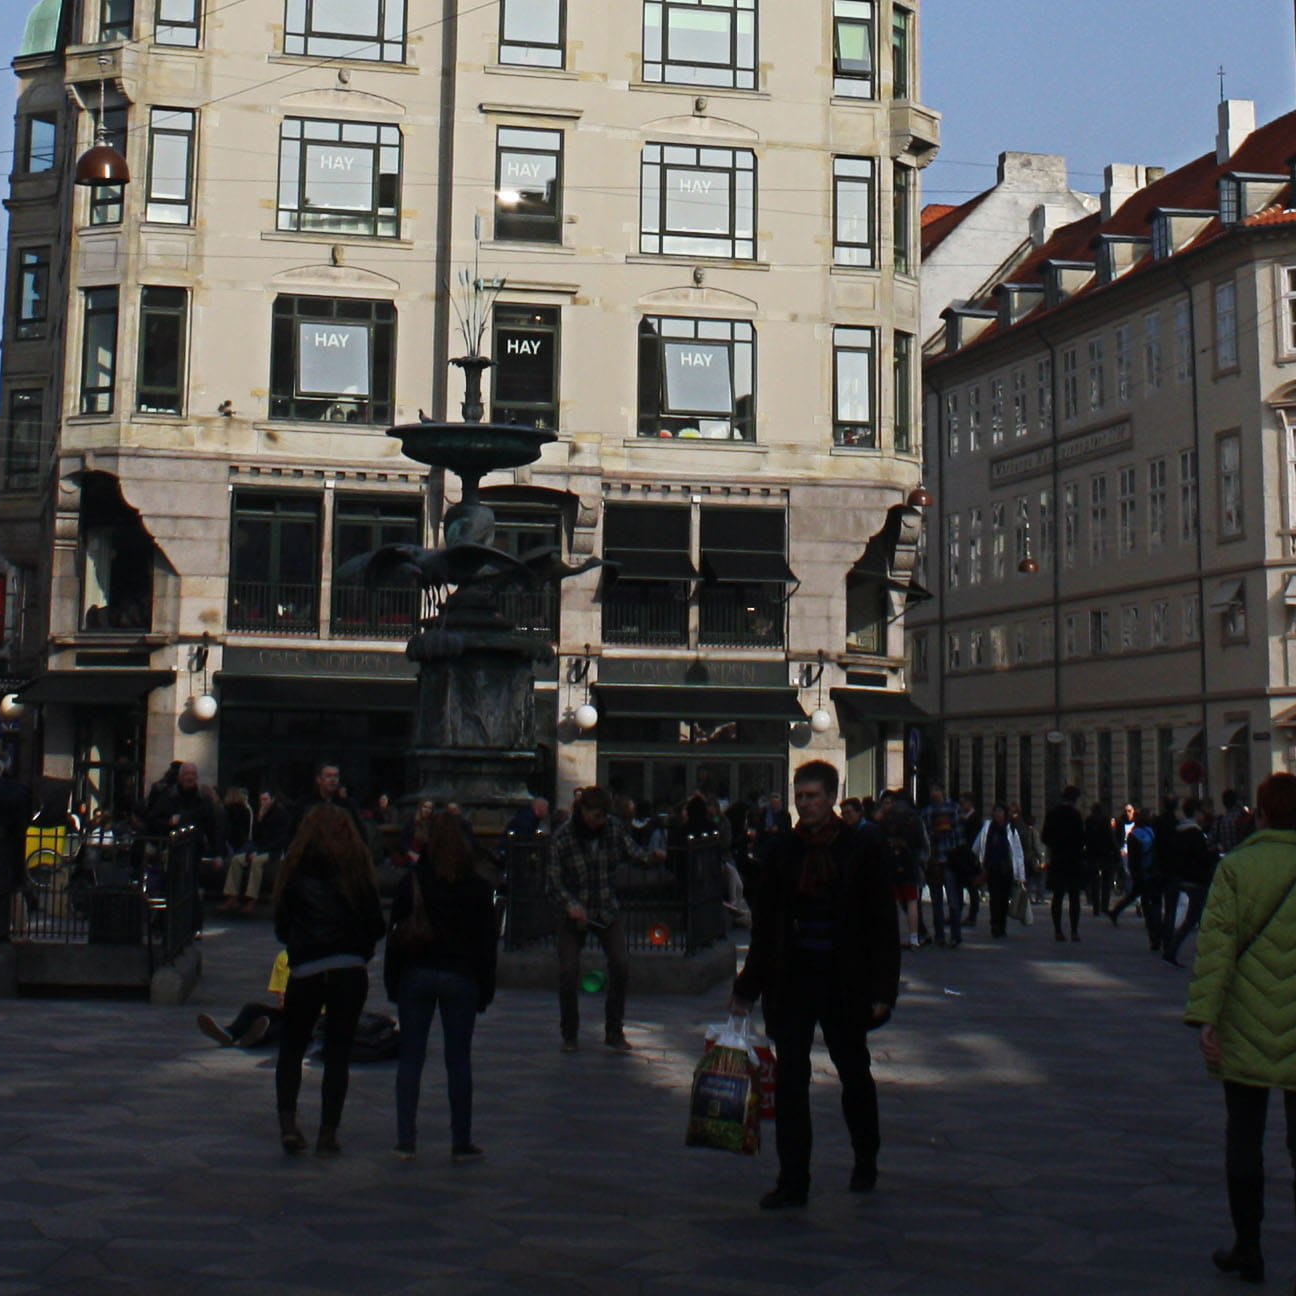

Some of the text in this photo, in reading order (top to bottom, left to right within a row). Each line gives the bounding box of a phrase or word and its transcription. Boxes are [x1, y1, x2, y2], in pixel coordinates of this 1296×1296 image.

[321, 155, 354, 171] HAY
[507, 161, 541, 179] HAY
[680, 178, 712, 195] HAY
[315, 333, 350, 349] HAY
[507, 339, 542, 356] HAY
[680, 352, 714, 368] HAY
